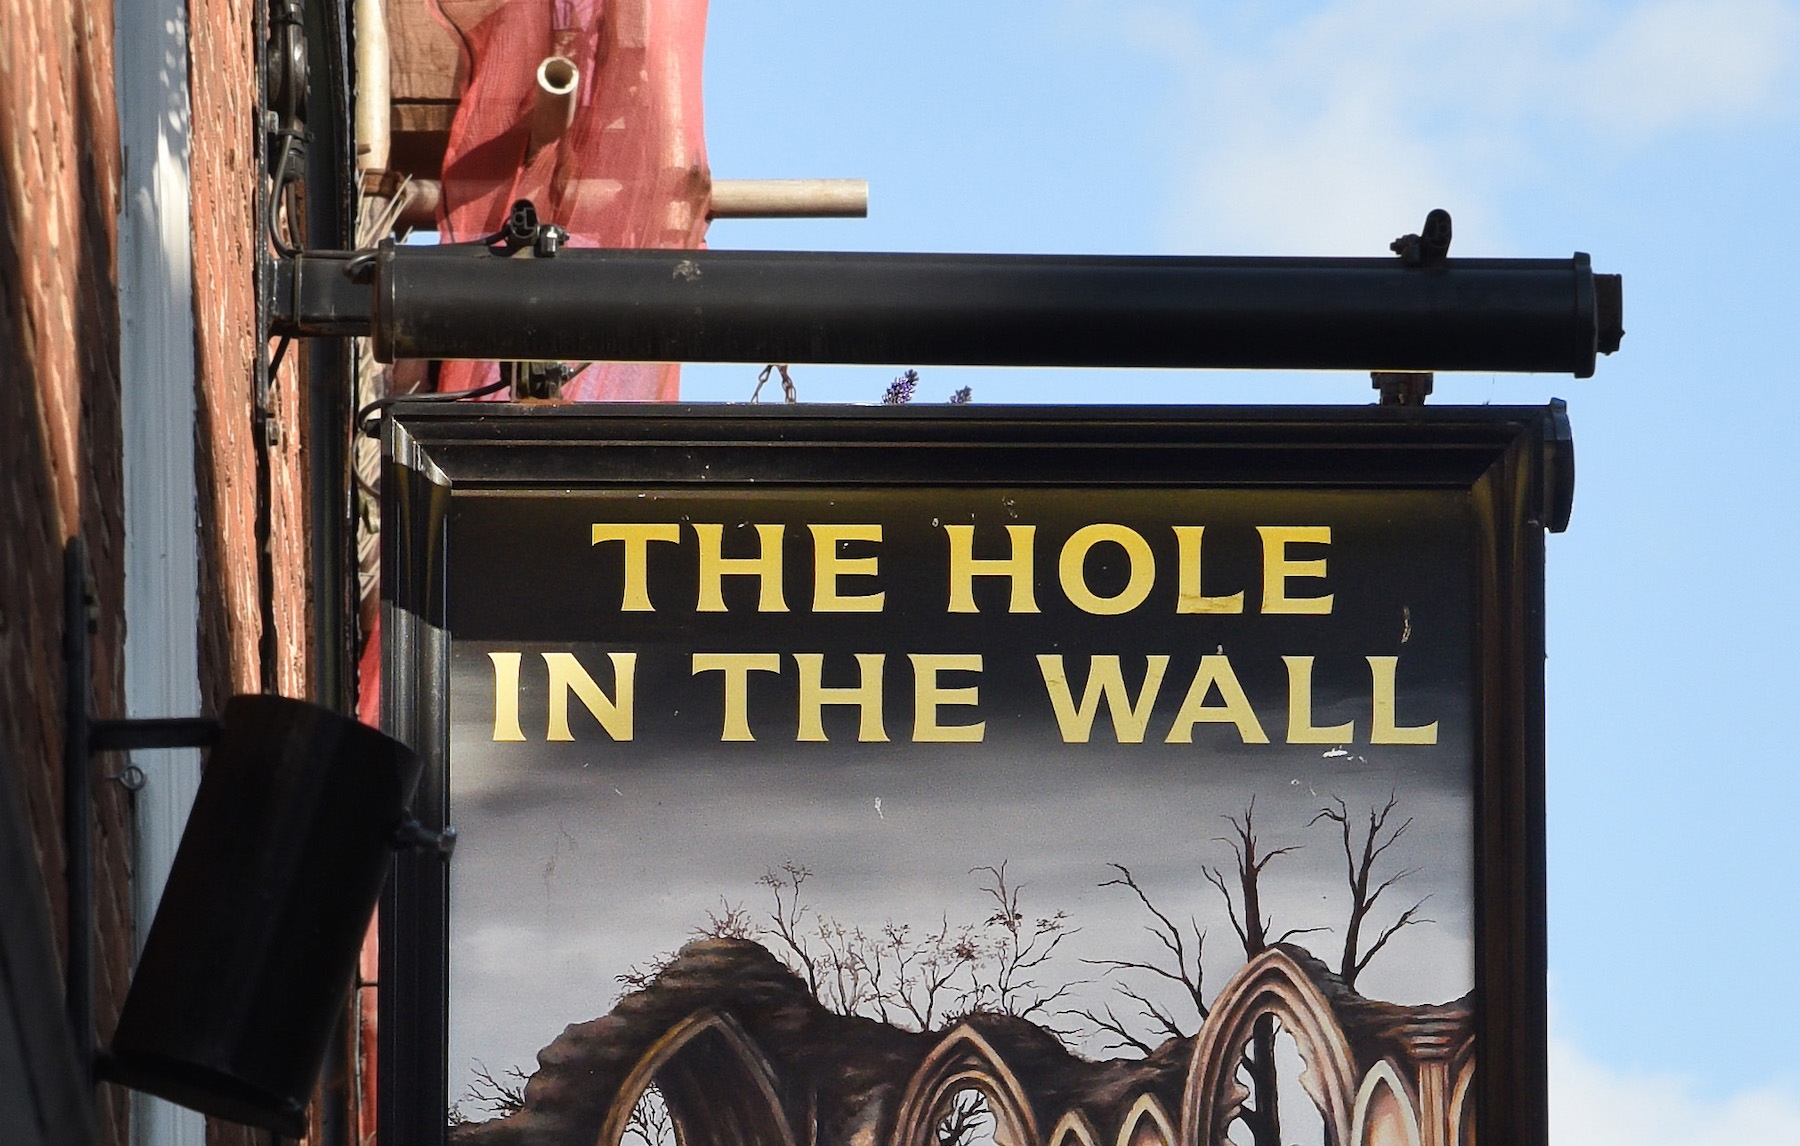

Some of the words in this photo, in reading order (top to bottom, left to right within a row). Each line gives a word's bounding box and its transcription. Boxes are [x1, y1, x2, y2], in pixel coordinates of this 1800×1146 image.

[590, 522, 886, 614] THE
[944, 522, 1335, 617] HOLE
[488, 652, 637, 744] IN
[691, 652, 987, 744] THE
[1036, 653, 1440, 746] WALL
